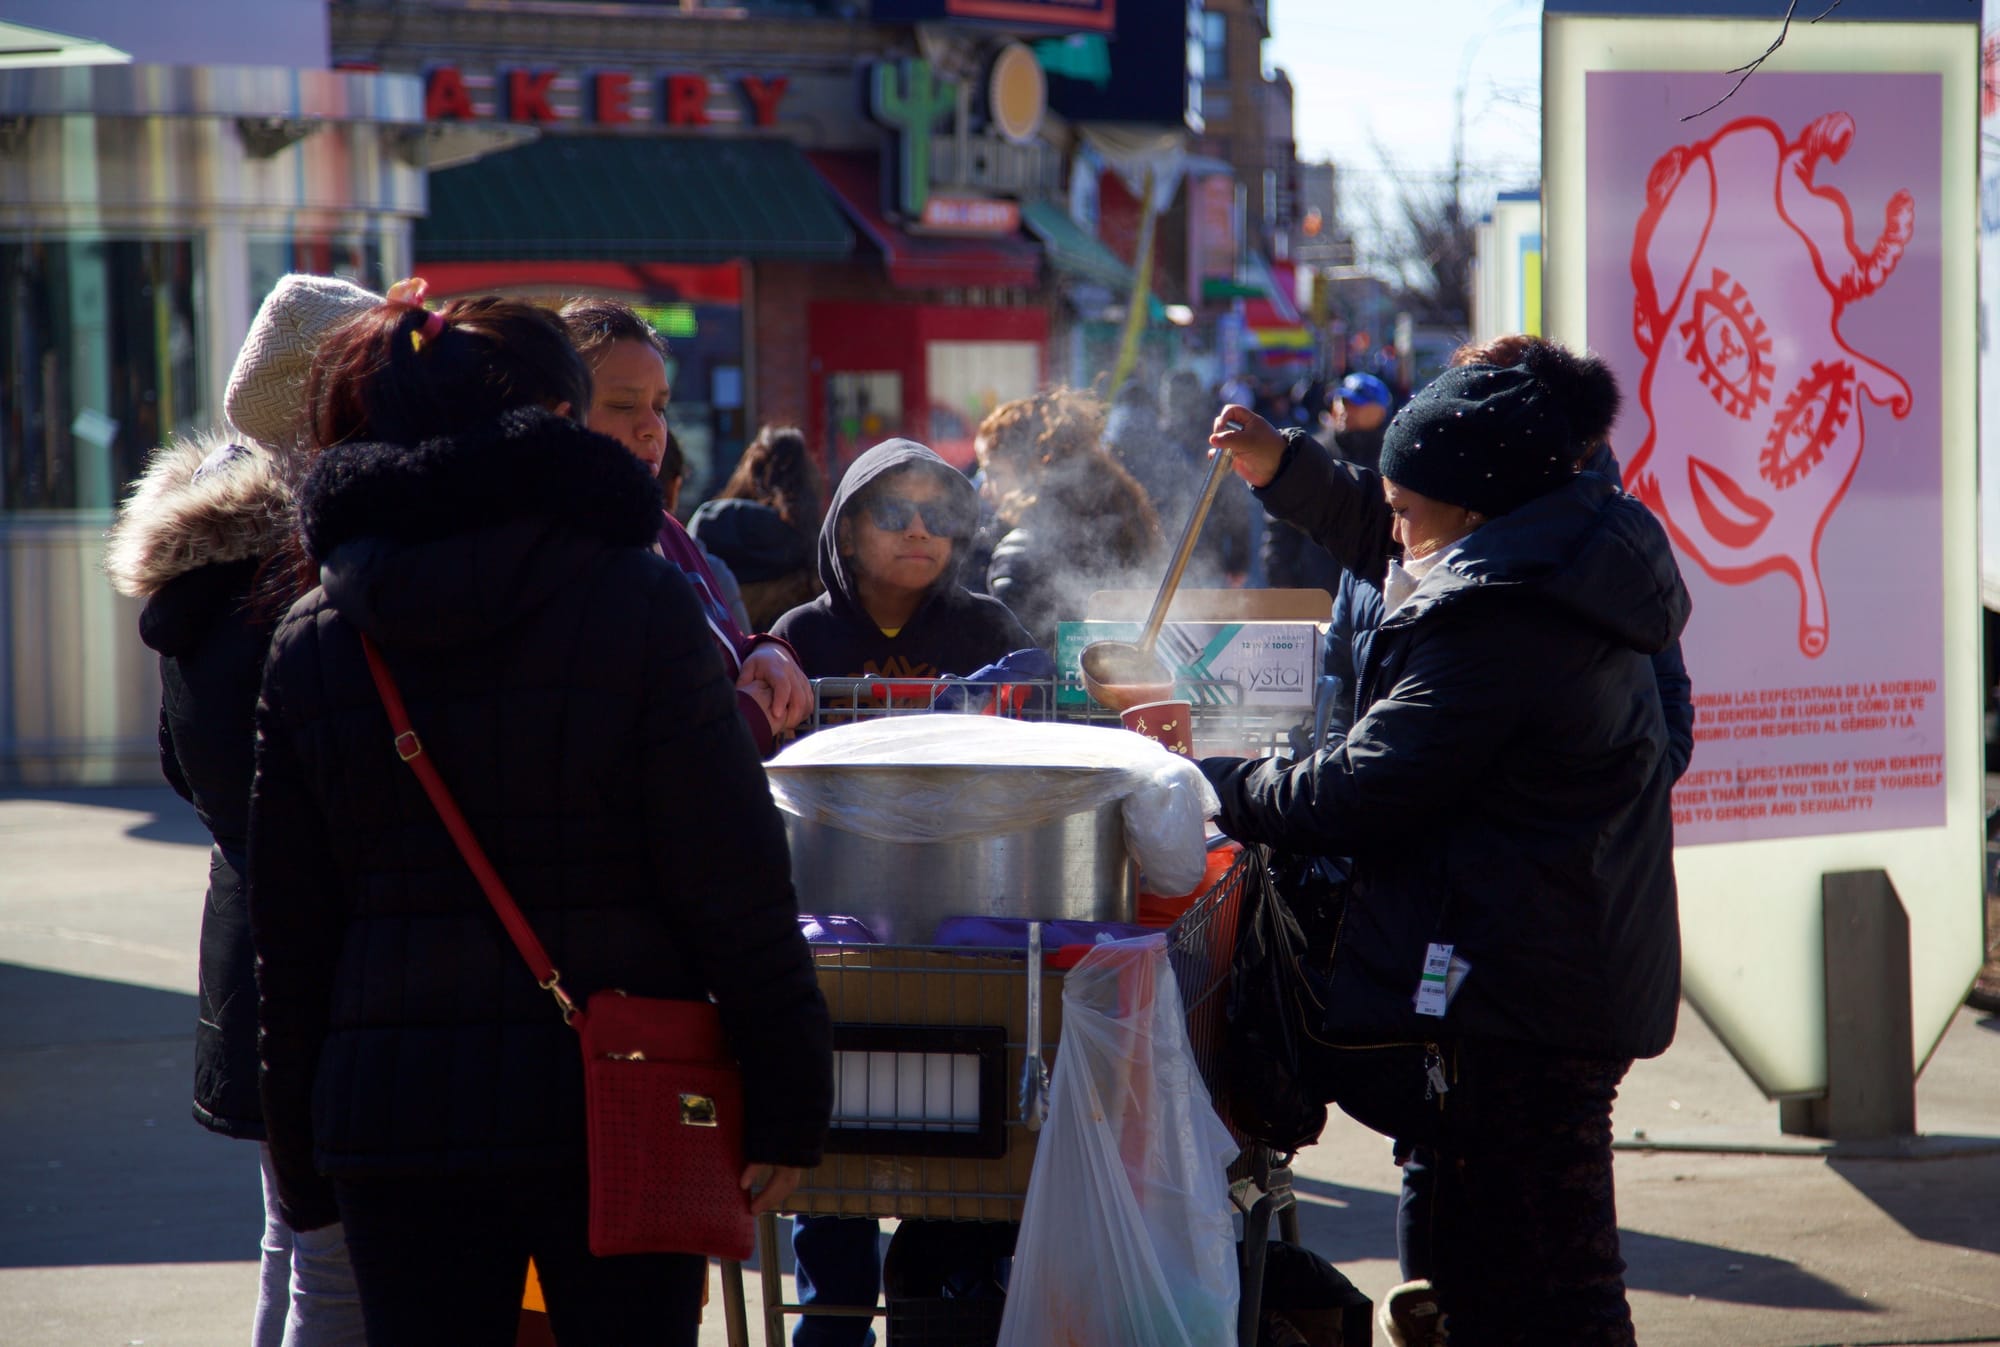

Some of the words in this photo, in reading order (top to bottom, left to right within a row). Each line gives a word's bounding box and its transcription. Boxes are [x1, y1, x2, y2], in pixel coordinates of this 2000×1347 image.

[334, 62, 789, 126] AKERY
[1220, 660, 1304, 692] crystal
[1735, 691, 1756, 705] LAS
[1760, 686, 1842, 704] EXPECTATIVAS
[1846, 684, 1859, 698] DE
[1863, 683, 1877, 697] LA
[1880, 680, 1936, 695] SOCIEDAD
[1700, 710, 1715, 724] SU
[1718, 706, 1776, 723] IDENTIDAD
[1780, 705, 1795, 718] EN
[1799, 703, 1836, 718] LUGAR
[1840, 702, 1853, 715] DE
[1893, 698, 1906, 711] SE
[1910, 697, 1924, 710] VE
[1734, 725, 1758, 740] CON
[1761, 721, 1820, 738] RESPECTO
[1824, 720, 1837, 734] AL
[1890, 715, 1897, 728] Y
[1901, 714, 1915, 728] LA
[1676, 770, 1732, 787] OCIETY'S
[1736, 763, 1828, 783] EXPECTATIONS
[1833, 761, 1849, 775] OF
[1853, 758, 1886, 773] YOUR
[1890, 754, 1943, 771] IDENTITY
[1711, 787, 1745, 803] THAN
[1748, 785, 1778, 800] HOW
[1782, 783, 1808, 797] YOU
[1811, 780, 1849, 795] TRULY
[1854, 778, 1875, 792] SEE
[1880, 772, 1943, 789] YOURSELF
[1696, 808, 1712, 822] TO
[1716, 804, 1766, 821] GENDER
[1771, 802, 1796, 816] AND
[1801, 796, 1873, 815] SEXUALITY?
